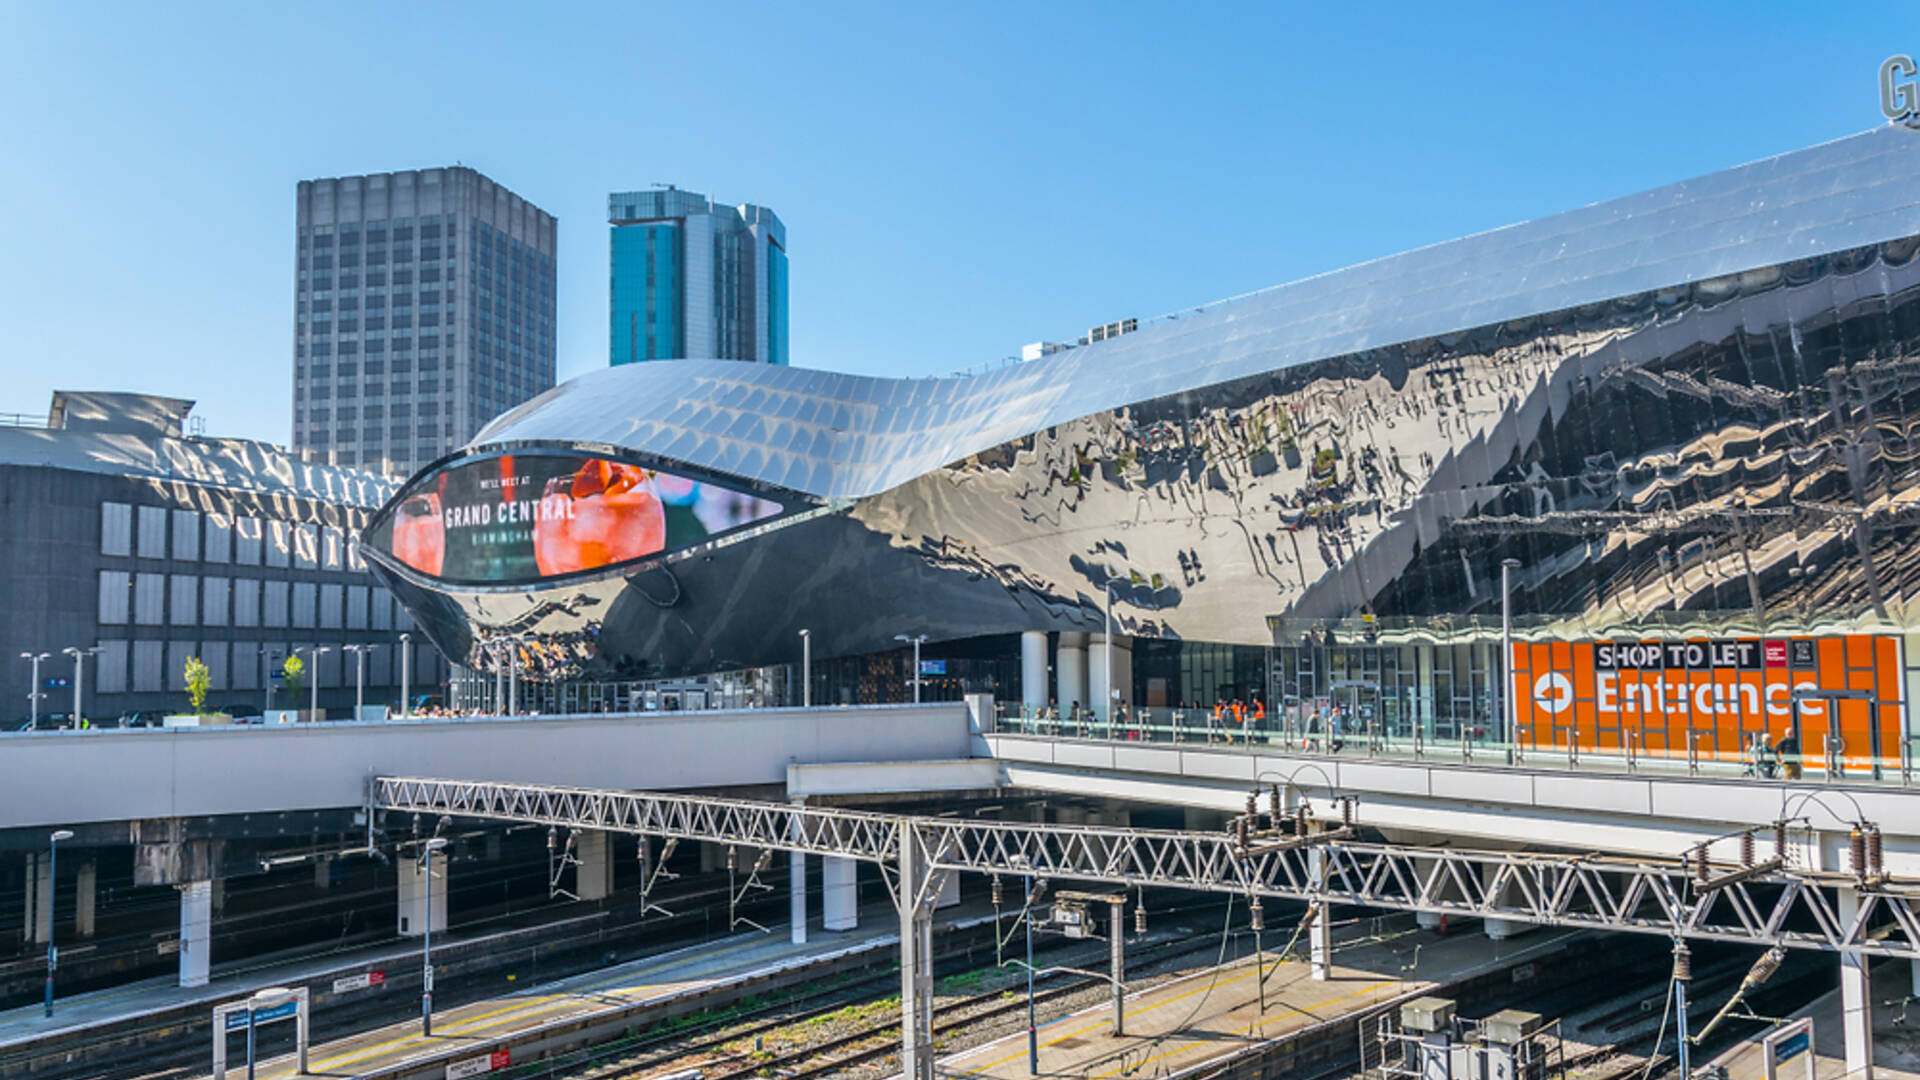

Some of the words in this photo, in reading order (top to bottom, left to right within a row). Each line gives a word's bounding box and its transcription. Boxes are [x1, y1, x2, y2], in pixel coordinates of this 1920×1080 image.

[445, 503, 491, 529] GRAND
[498, 499, 576, 524] CENTRAL
[1598, 645, 1661, 667] SHOP
[1668, 645, 1704, 667] TO
[1711, 644, 1753, 666] LET
[1597, 671, 1824, 716] Entrance
